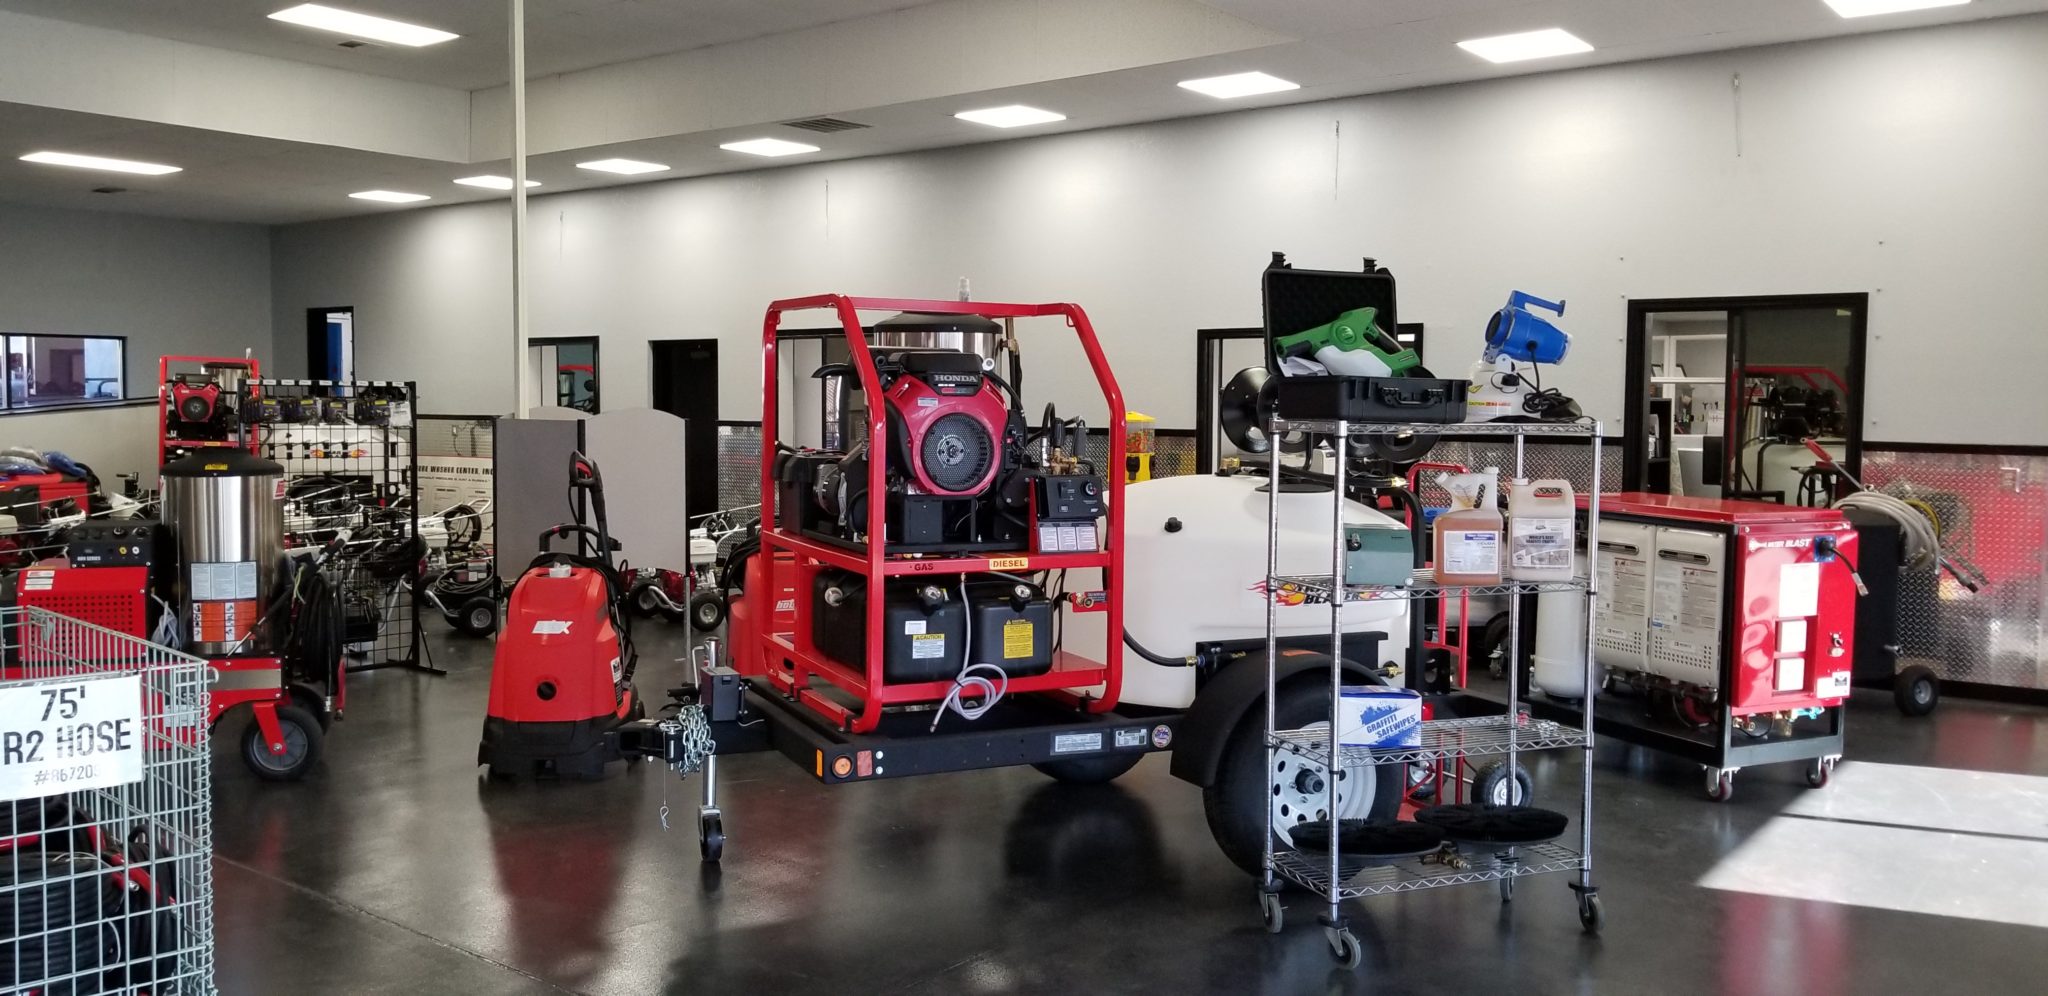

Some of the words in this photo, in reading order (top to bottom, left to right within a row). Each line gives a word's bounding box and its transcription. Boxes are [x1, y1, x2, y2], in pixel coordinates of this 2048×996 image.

[934, 374, 978, 382] HONDA
[430, 465, 455, 474] WASHER
[1785, 538, 1812, 548] BLAST
[914, 563, 934, 571] GAS
[992, 559, 1025, 568] DIESEL
[40, 685, 86, 722] 75'
[1366, 713, 1398, 734] GRAFFITI
[1376, 714, 1416, 738] SAFEWIPES
[3, 729, 45, 766] R2
[56, 718, 132, 759] HOSE
